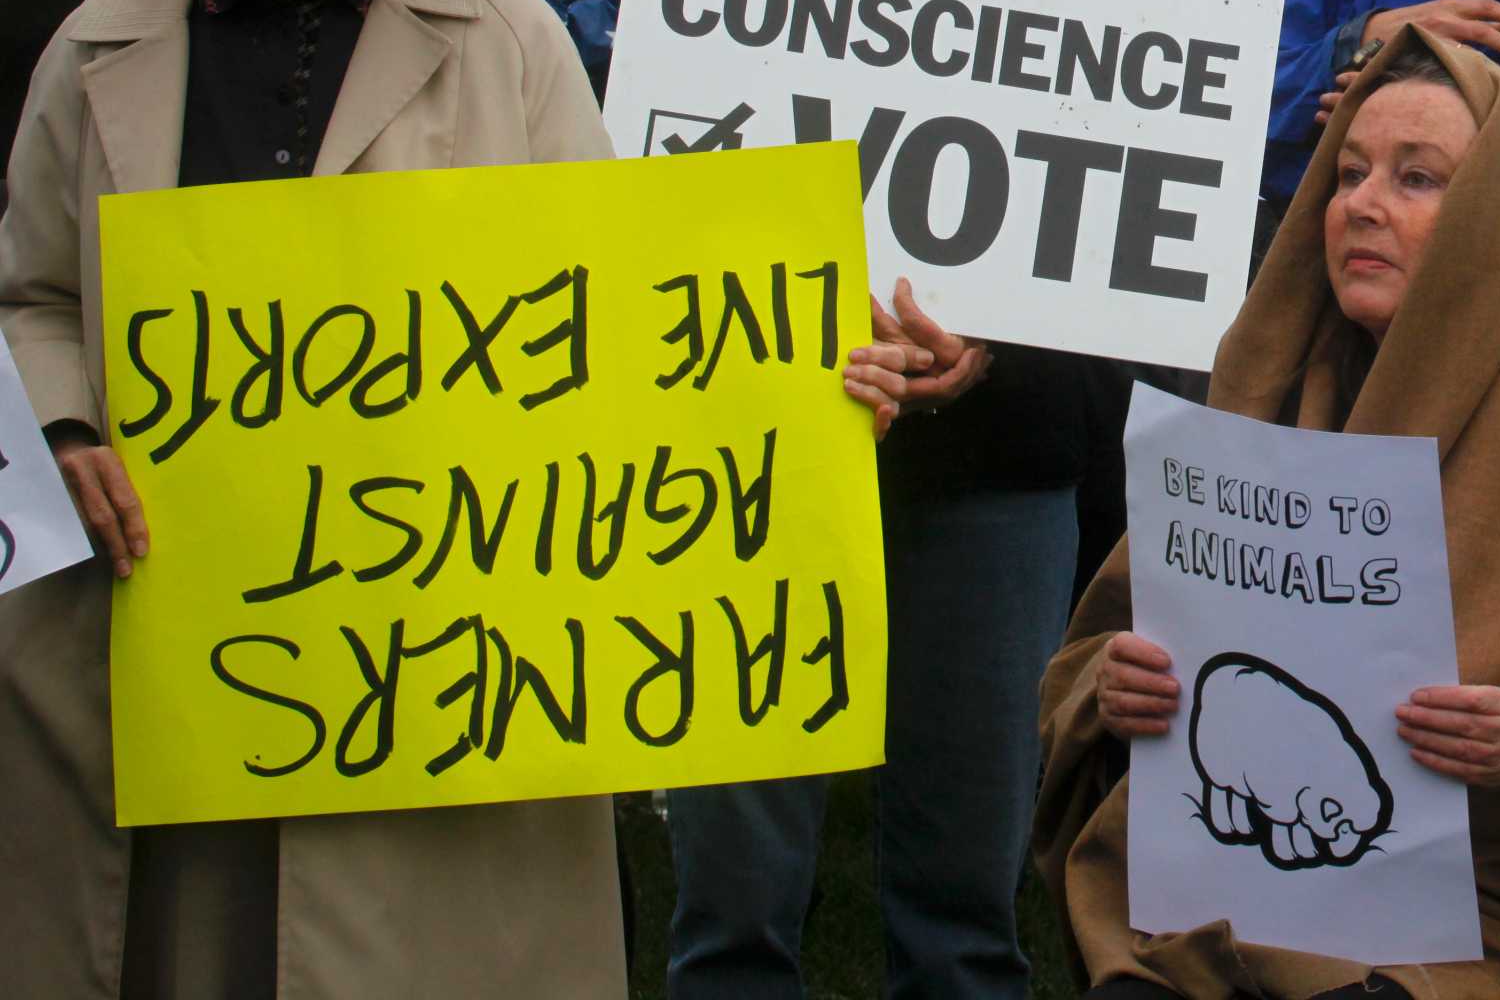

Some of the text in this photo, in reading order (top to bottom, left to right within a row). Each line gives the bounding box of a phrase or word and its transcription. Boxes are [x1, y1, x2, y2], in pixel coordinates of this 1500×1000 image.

[791, 93, 1224, 303] VOTE
[118, 261, 839, 465] LIVE EXPORTS
[242, 427, 778, 604] AGAINST
[1163, 457, 1392, 536] BE KIND TO
[1165, 520, 1402, 606] ANIMALS
[210, 578, 849, 778] FARMERS
